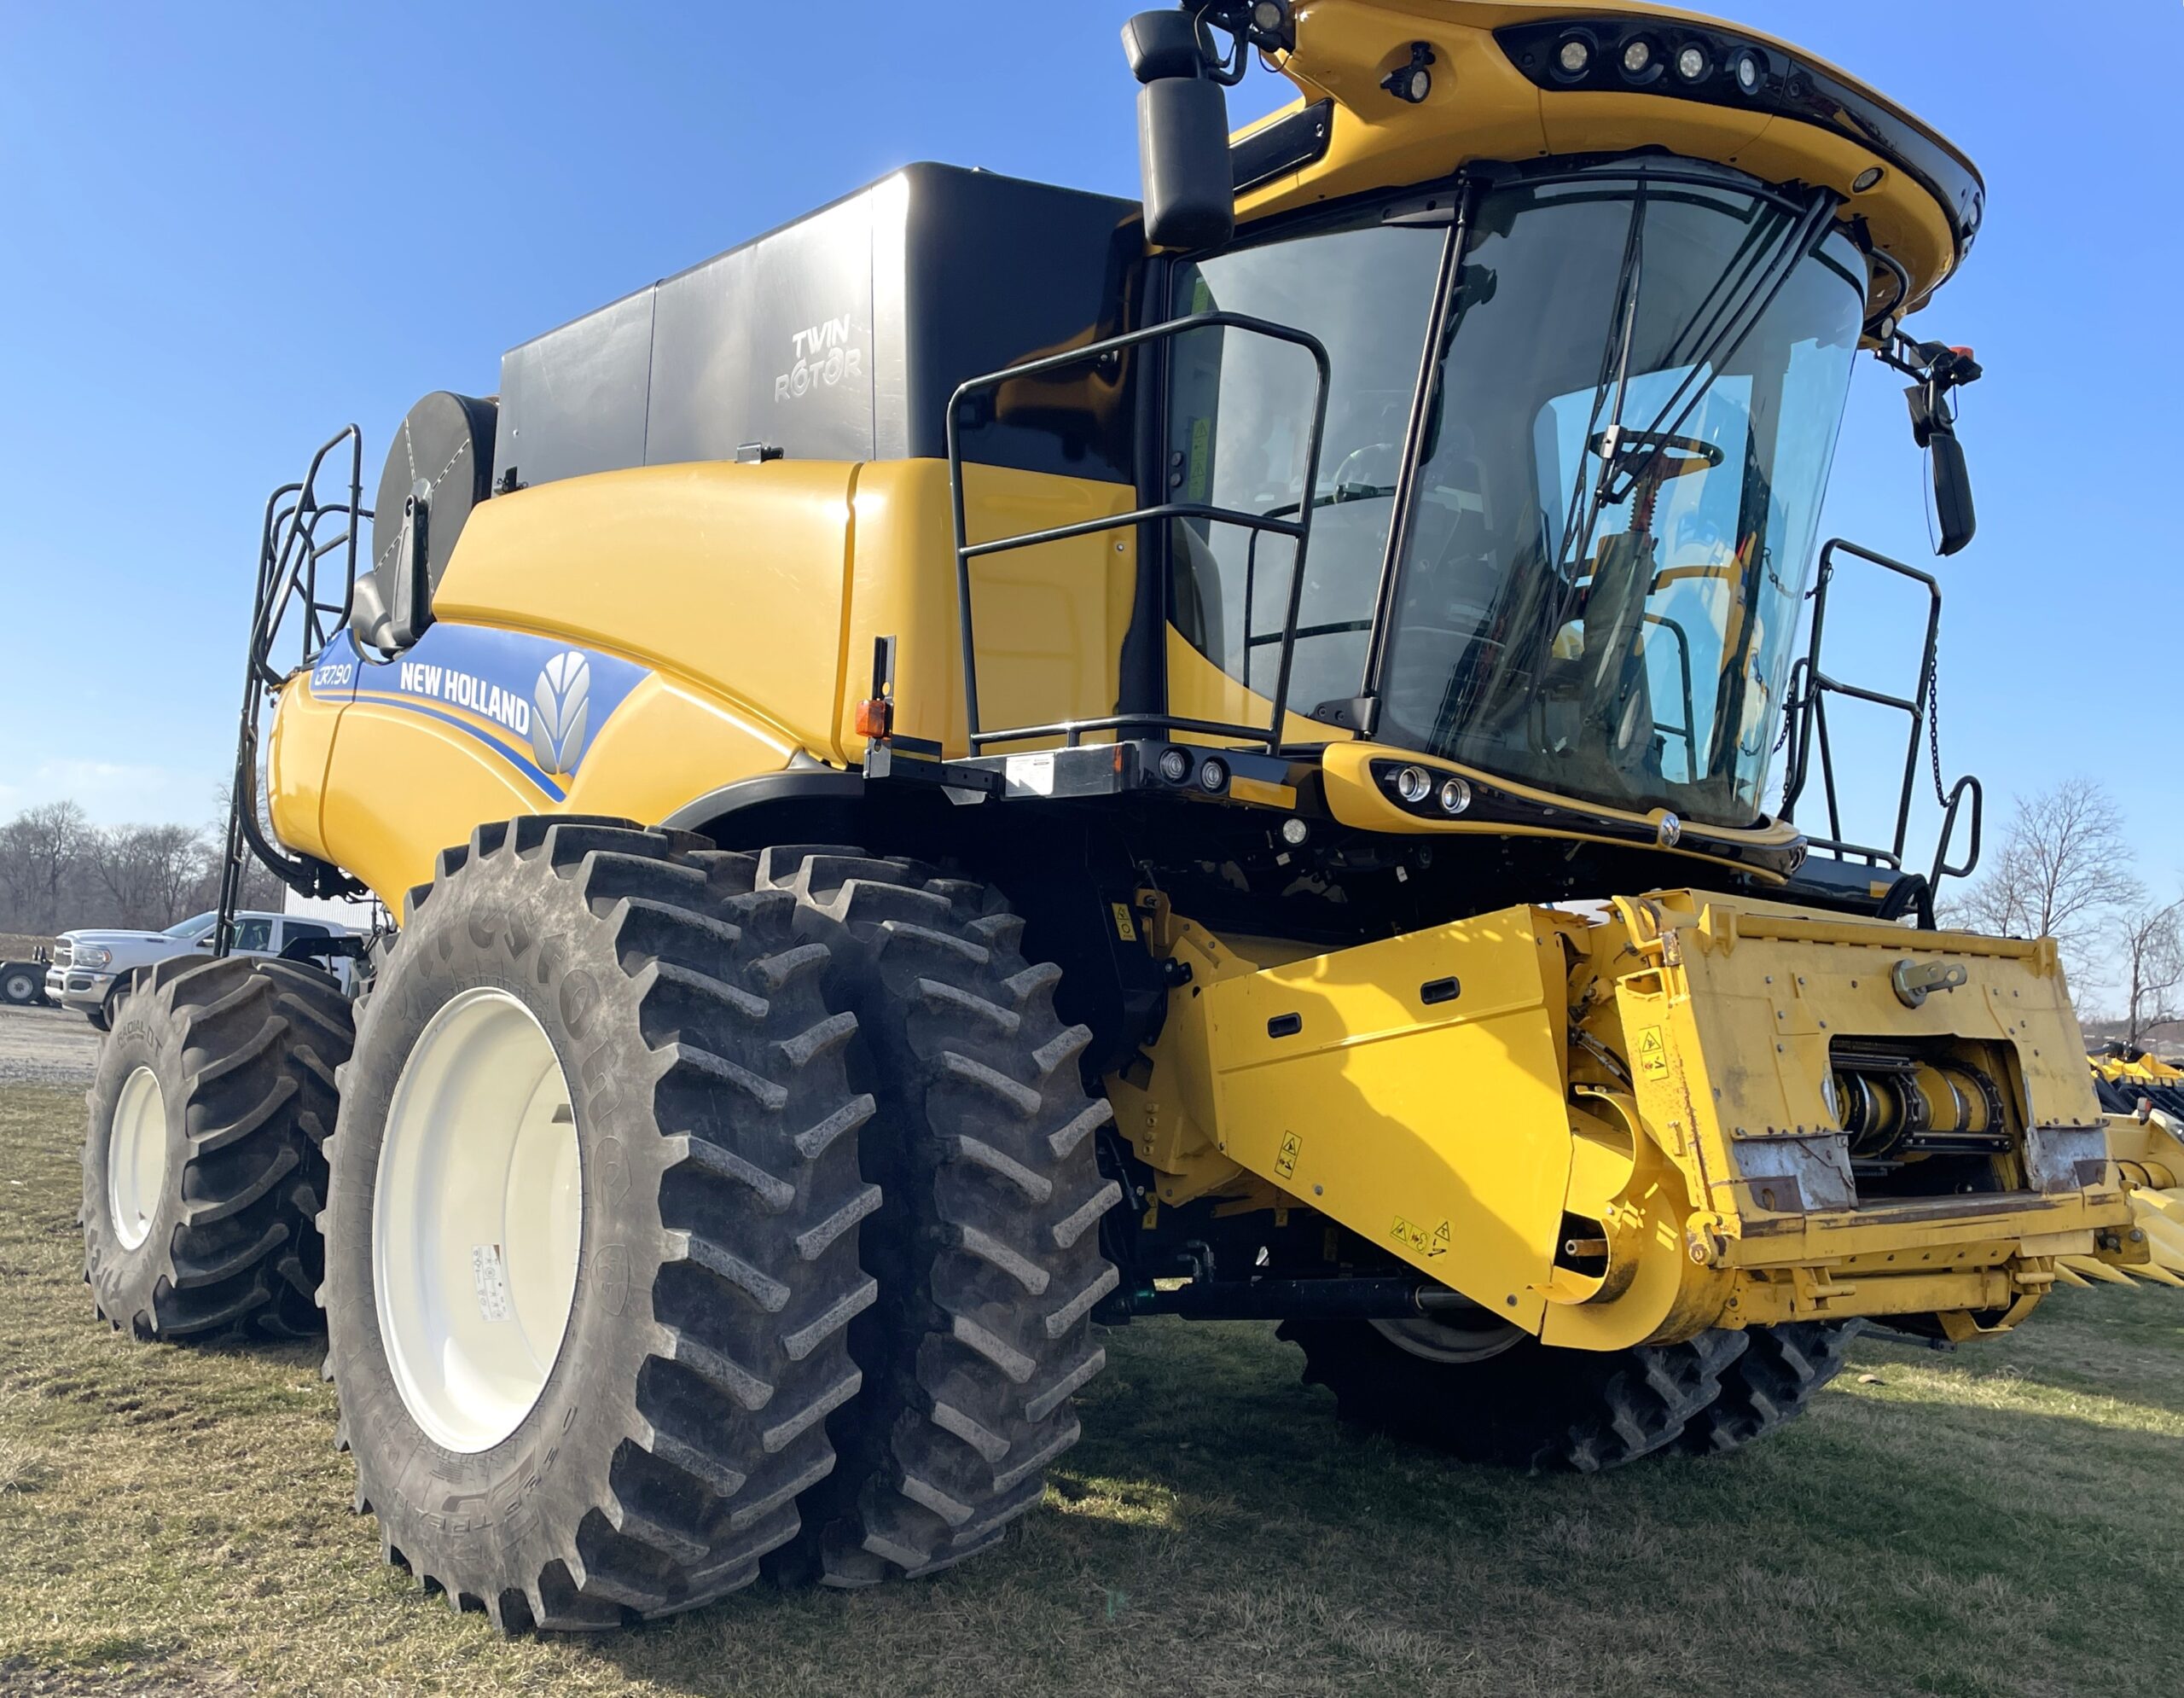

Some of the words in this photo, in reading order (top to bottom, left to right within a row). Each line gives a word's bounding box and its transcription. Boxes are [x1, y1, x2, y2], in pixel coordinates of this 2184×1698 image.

[792, 313, 851, 359] TWIN
[774, 346, 862, 404] ROTOR
[400, 661, 442, 695] NEW
[444, 669, 530, 736] HOLLAND
